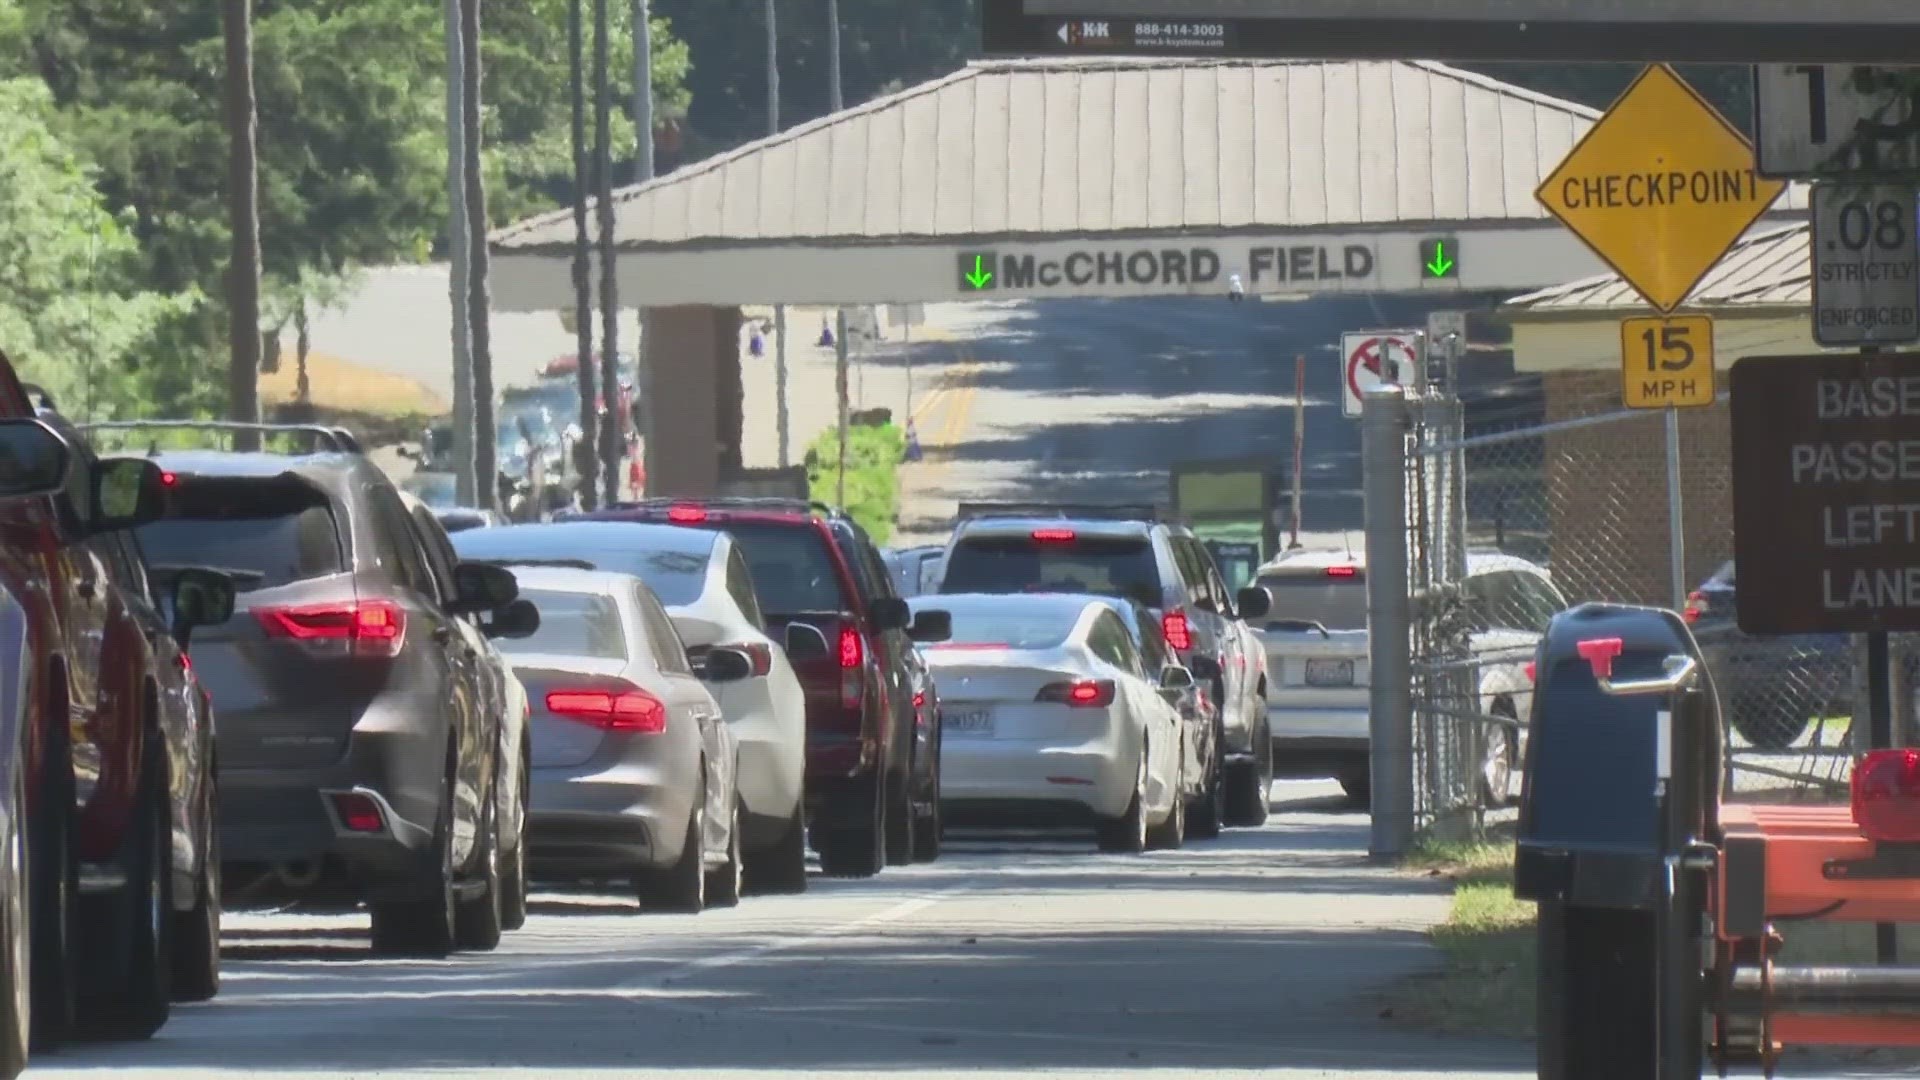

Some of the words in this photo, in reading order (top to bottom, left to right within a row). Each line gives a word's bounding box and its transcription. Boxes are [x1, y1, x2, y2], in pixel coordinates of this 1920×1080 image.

[1135, 23, 1224, 35] 888-414-3003
[1562, 168, 1758, 211] CHECKPOINT
[1826, 200, 1906, 251] .08
[1003, 247, 1221, 289] McCHORD
[1249, 245, 1374, 283] FIELD
[1821, 262, 1913, 282] STRICTLY
[1821, 306, 1914, 326] ENFORCED
[1641, 326, 1694, 372] 15
[1642, 379, 1696, 400] MPH
[1817, 377, 1920, 418] BASE
[1822, 504, 1920, 546] LEFT
